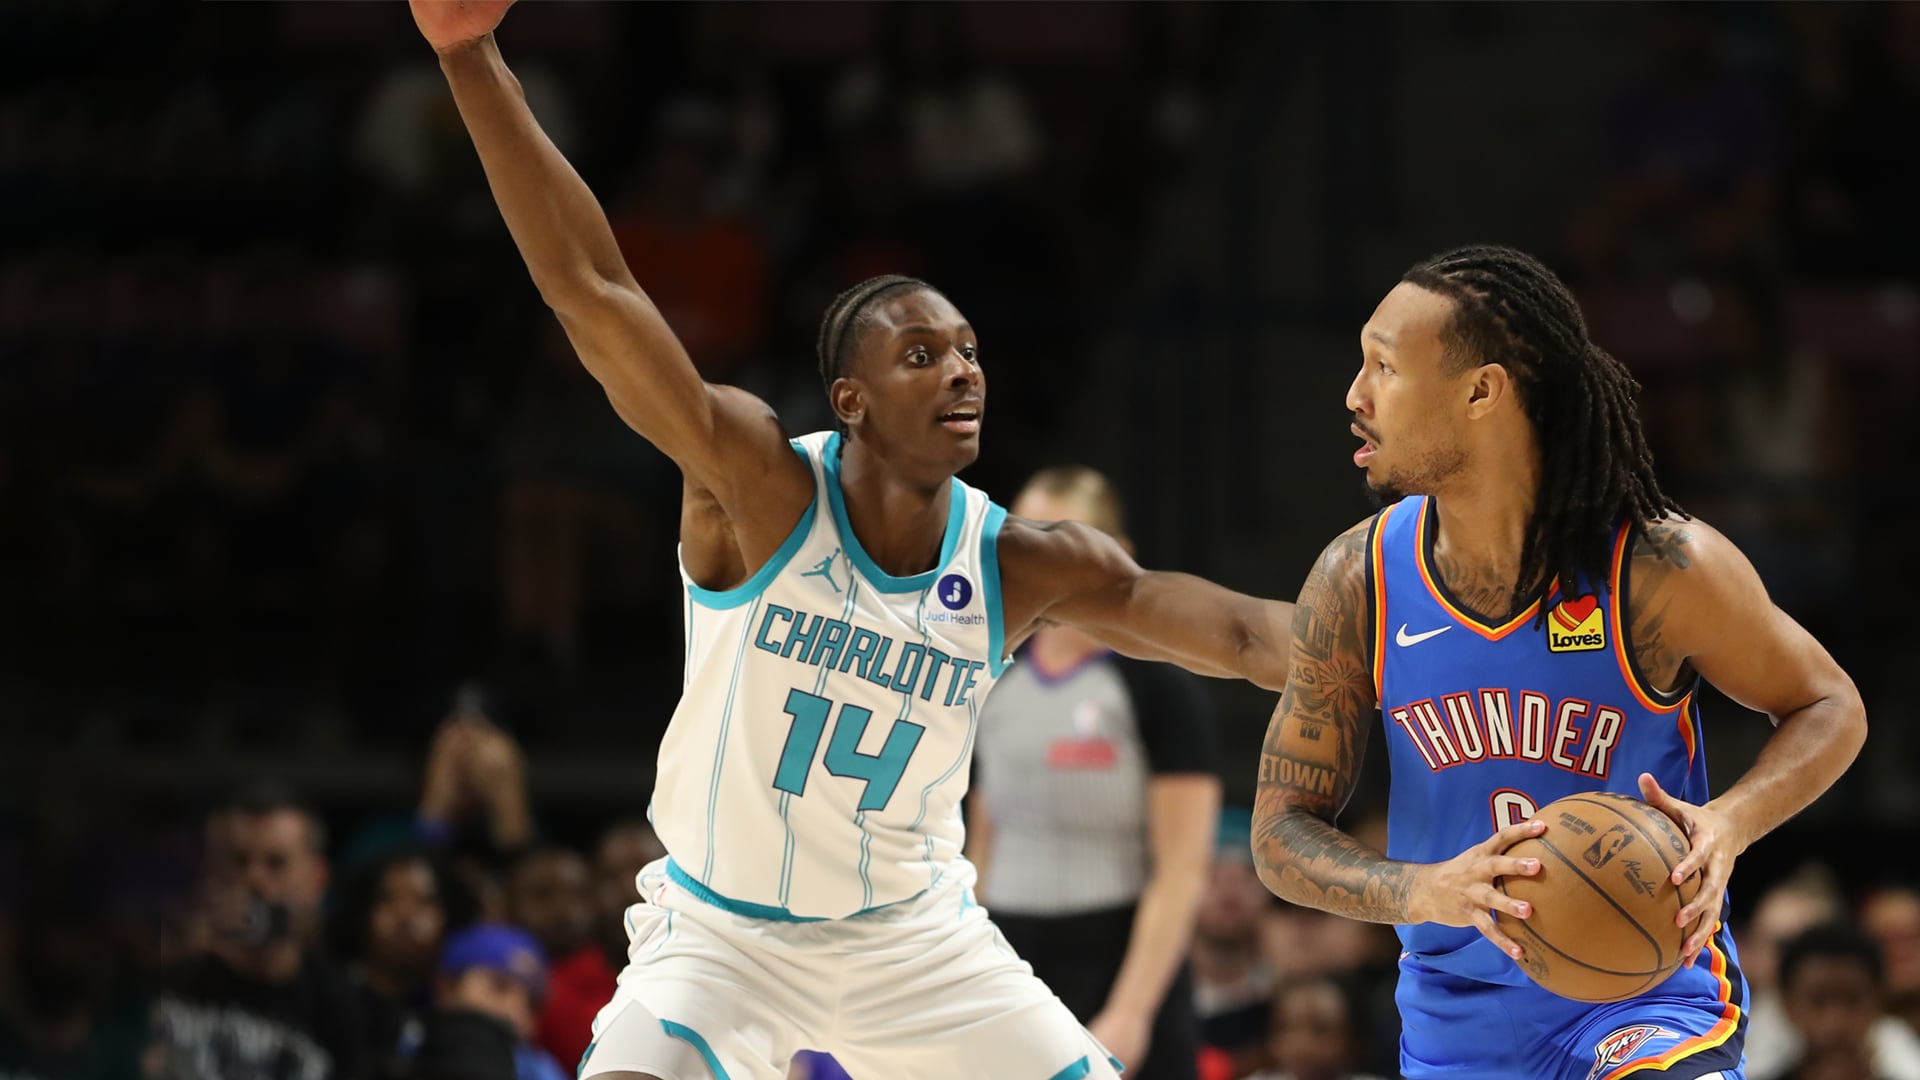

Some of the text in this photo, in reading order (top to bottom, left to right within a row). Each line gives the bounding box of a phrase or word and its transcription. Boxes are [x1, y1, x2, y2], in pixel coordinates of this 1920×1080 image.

[754, 603, 986, 707] CHARLOTTE
[925, 611, 985, 625] Judi Health
[772, 688, 926, 812] 14
[1390, 689, 1625, 779] THUNDER
